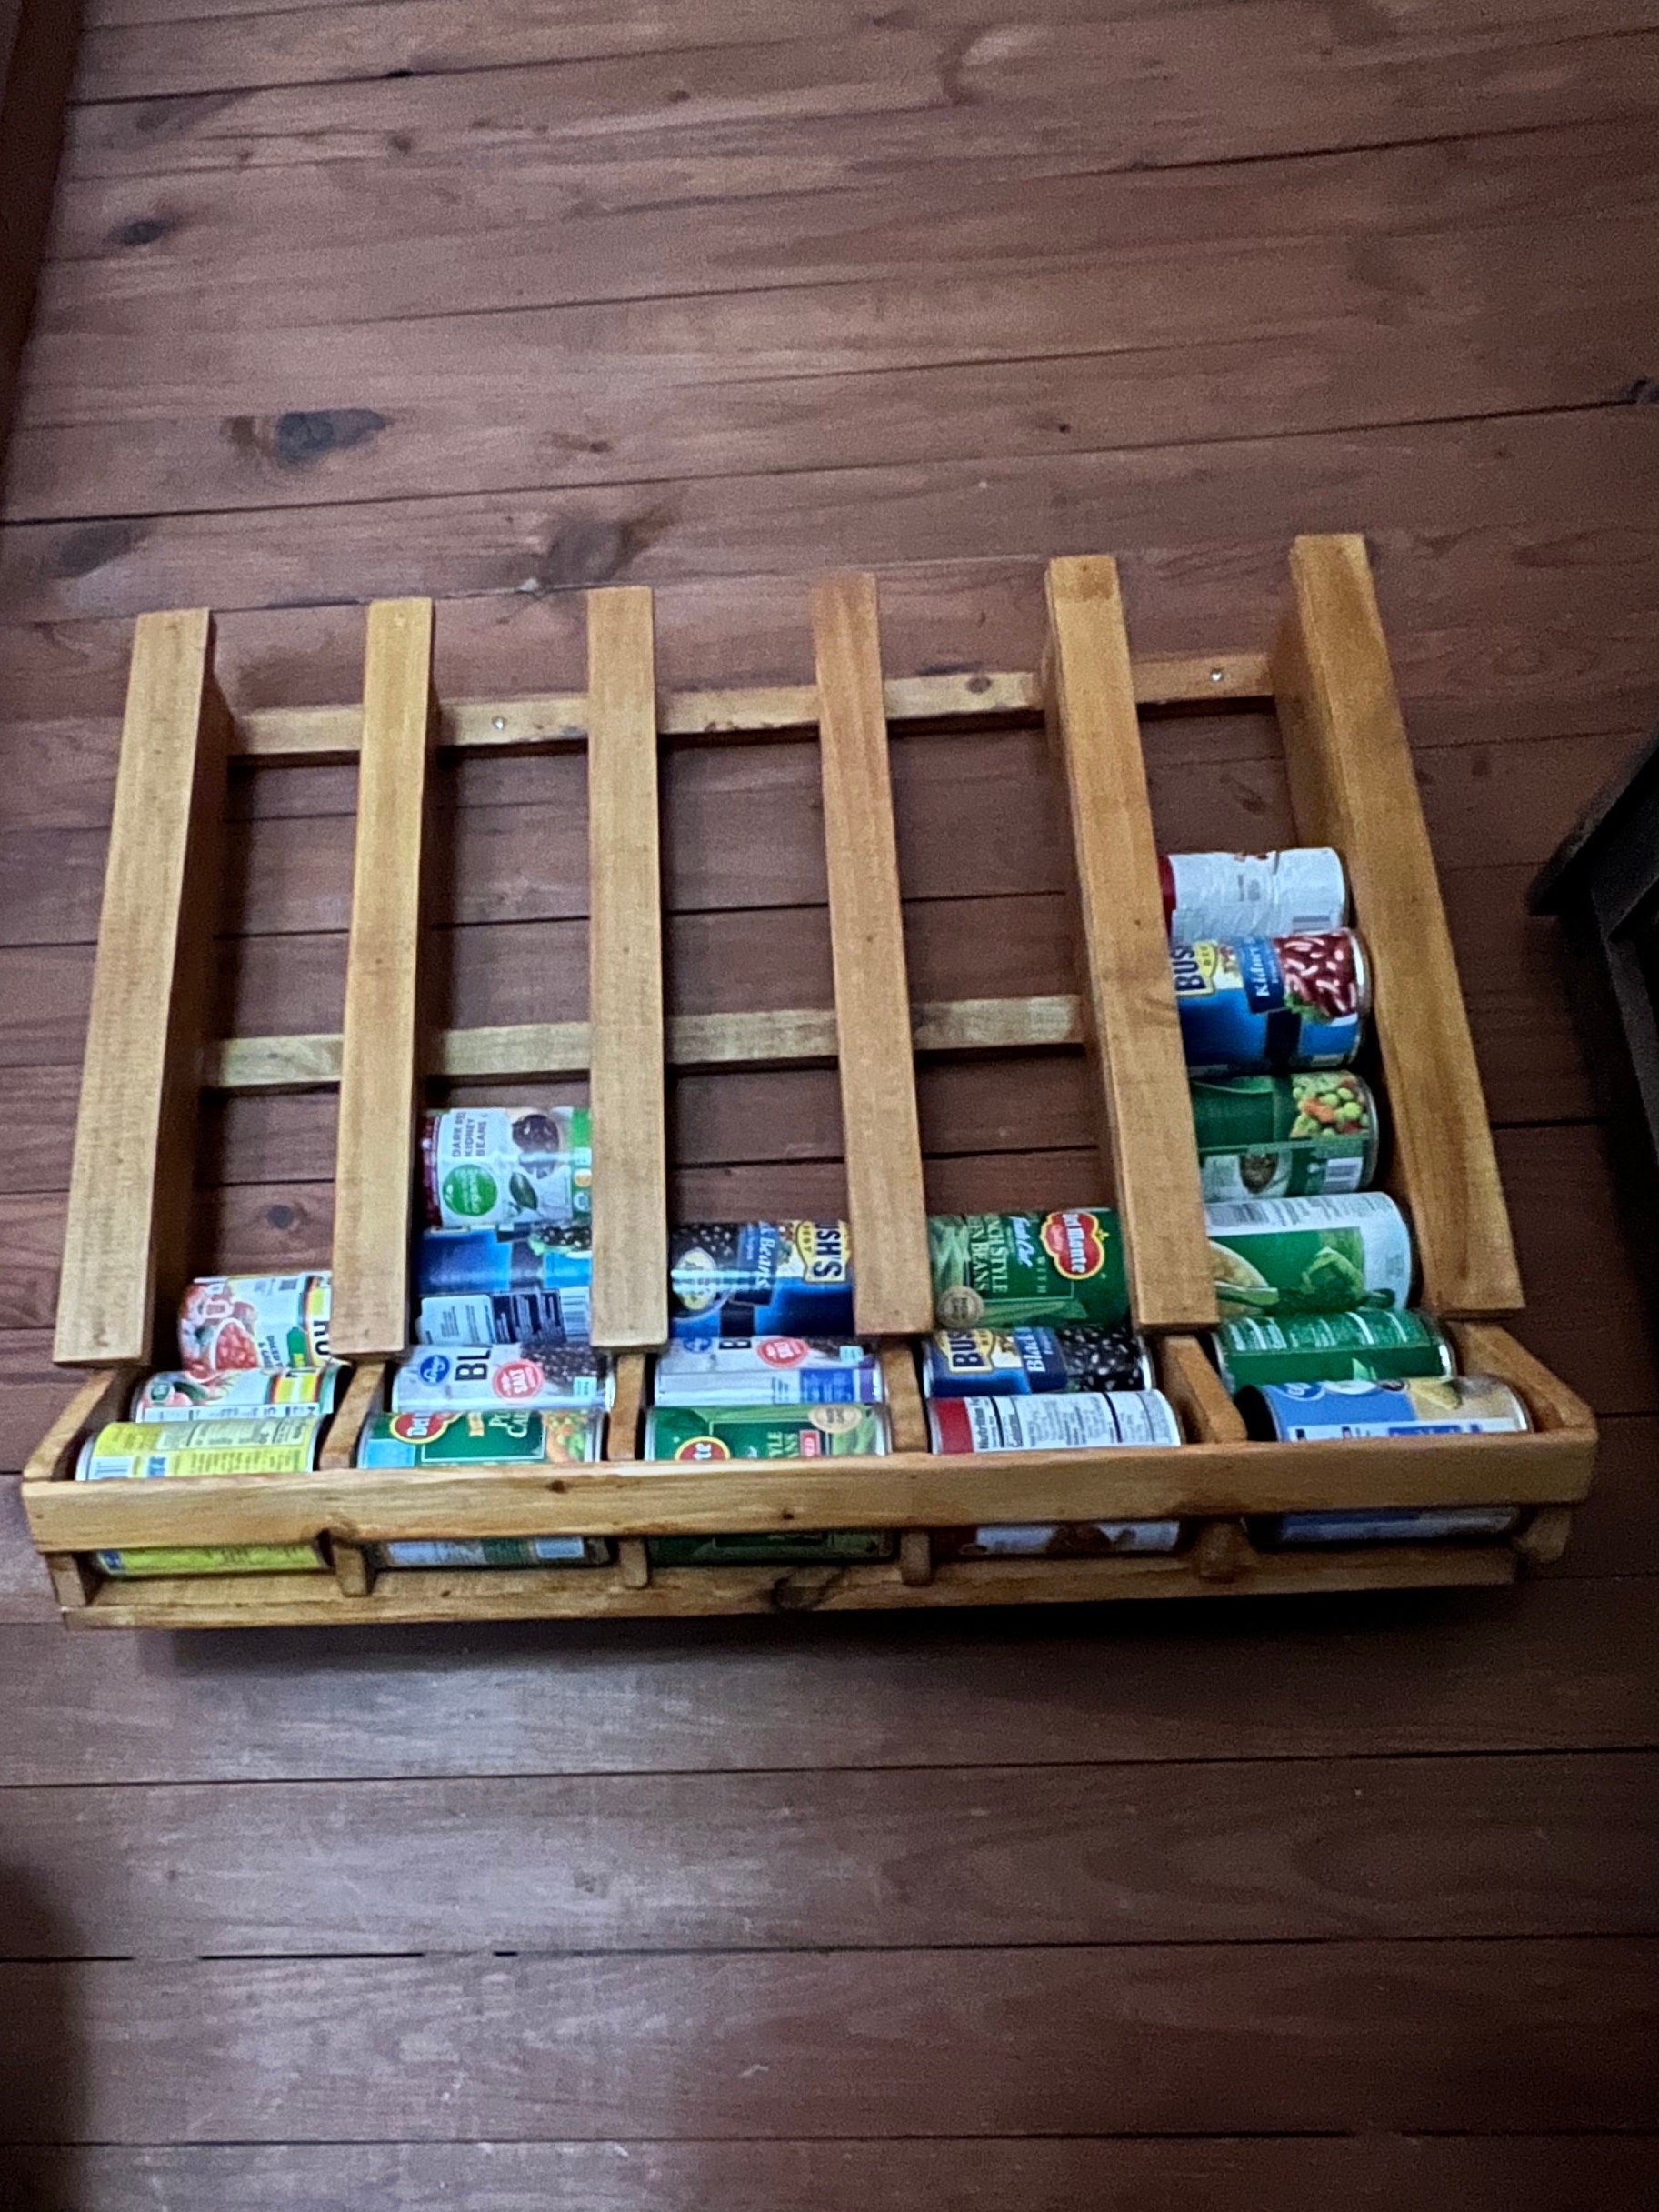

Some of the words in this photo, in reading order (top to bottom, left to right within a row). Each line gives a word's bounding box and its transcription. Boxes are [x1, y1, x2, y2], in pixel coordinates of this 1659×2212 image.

[452, 1127, 461, 1158] DARK
[465, 1118, 475, 1157] KIDNEY
[475, 1120, 486, 1157] BEANS
[754, 1236, 775, 1289] Beans
[970, 1242, 990, 1292] BEANS
[990, 1245, 1009, 1293] STYLE
[1065, 1227, 1088, 1274] Monte
[510, 1368, 529, 1395] SALT
